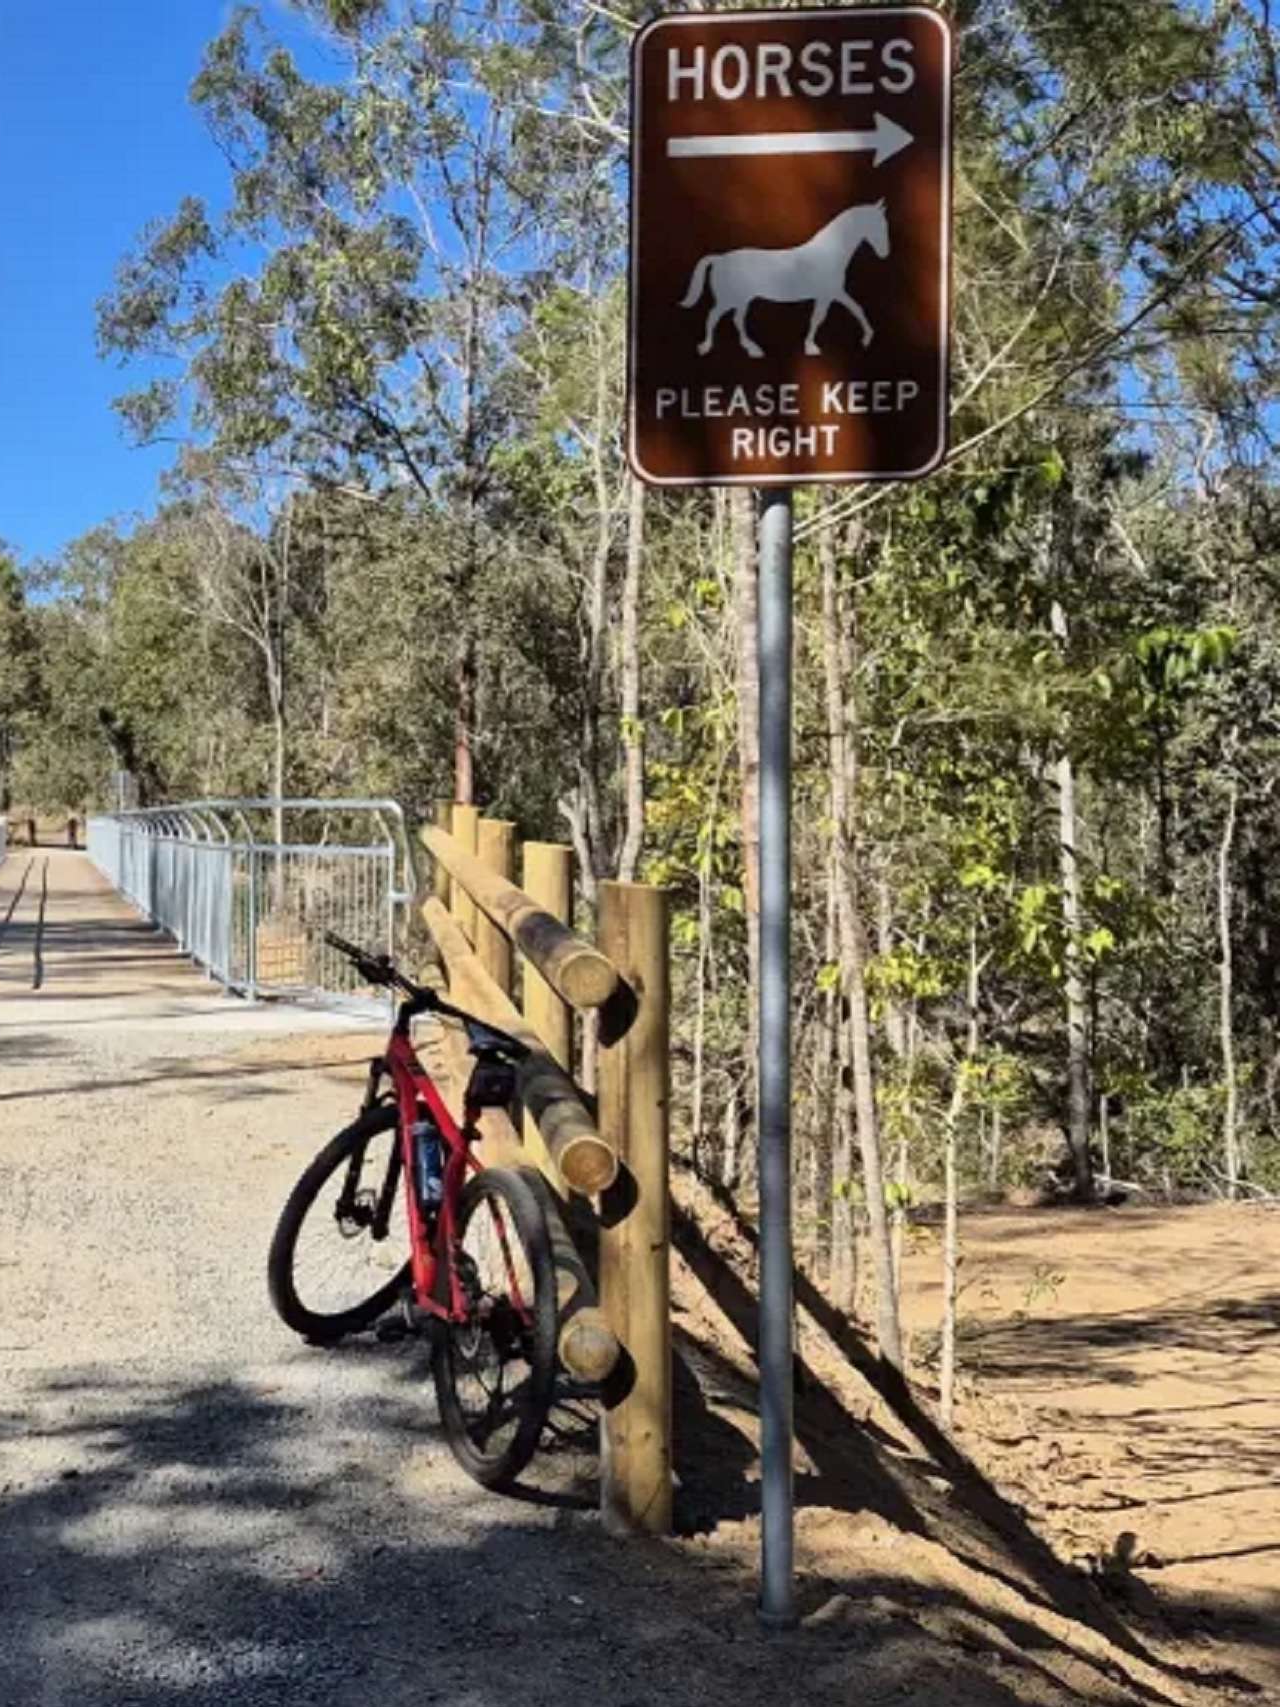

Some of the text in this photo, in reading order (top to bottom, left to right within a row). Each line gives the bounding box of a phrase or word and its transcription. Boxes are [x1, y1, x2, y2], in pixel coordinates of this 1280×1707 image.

[667, 39, 915, 100] HORSES
[656, 381, 919, 418] PLEASE KEEP
[732, 426, 840, 458] RIGHT
